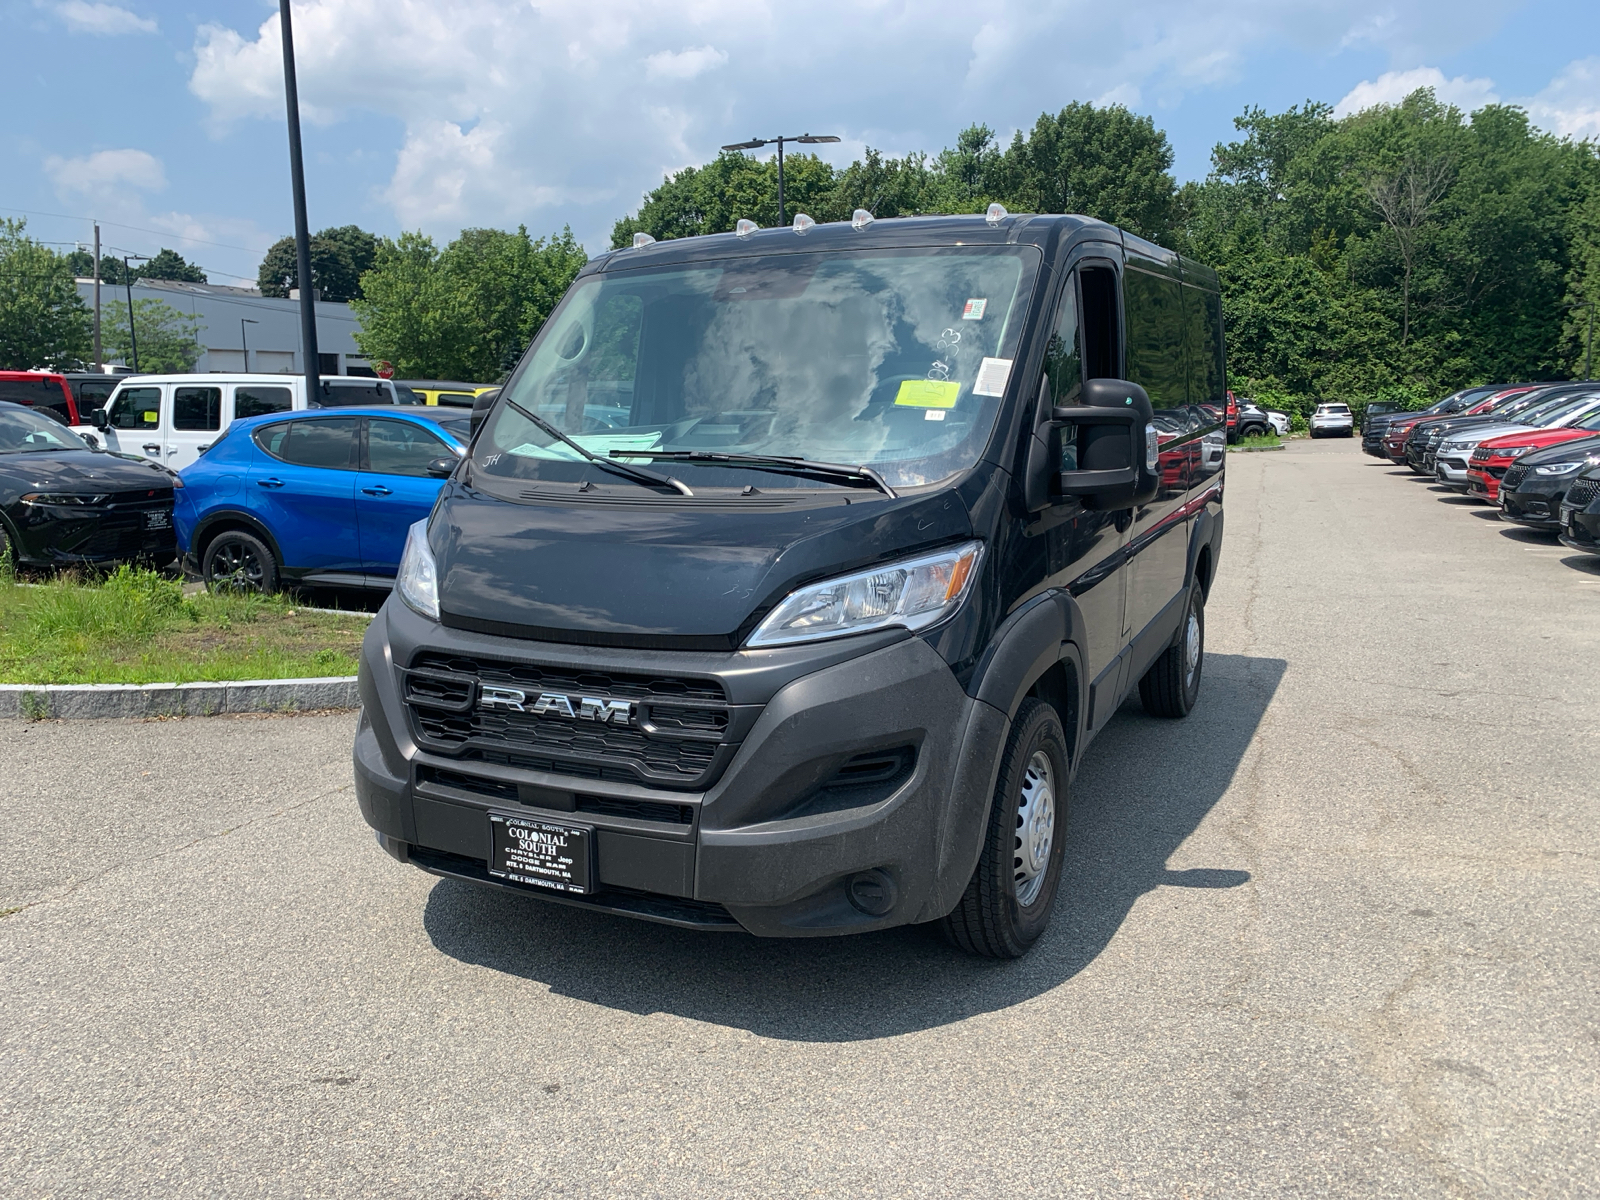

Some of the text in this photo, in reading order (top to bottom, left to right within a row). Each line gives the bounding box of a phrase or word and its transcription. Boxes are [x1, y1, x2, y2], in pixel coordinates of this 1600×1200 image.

[481, 686, 632, 725] RAM
[508, 827, 568, 847] COLONIAL
[504, 847, 573, 865] CHRYSLER Jeep
[519, 839, 557, 856] SOUTH
[510, 854, 567, 870] DODGE RAM
